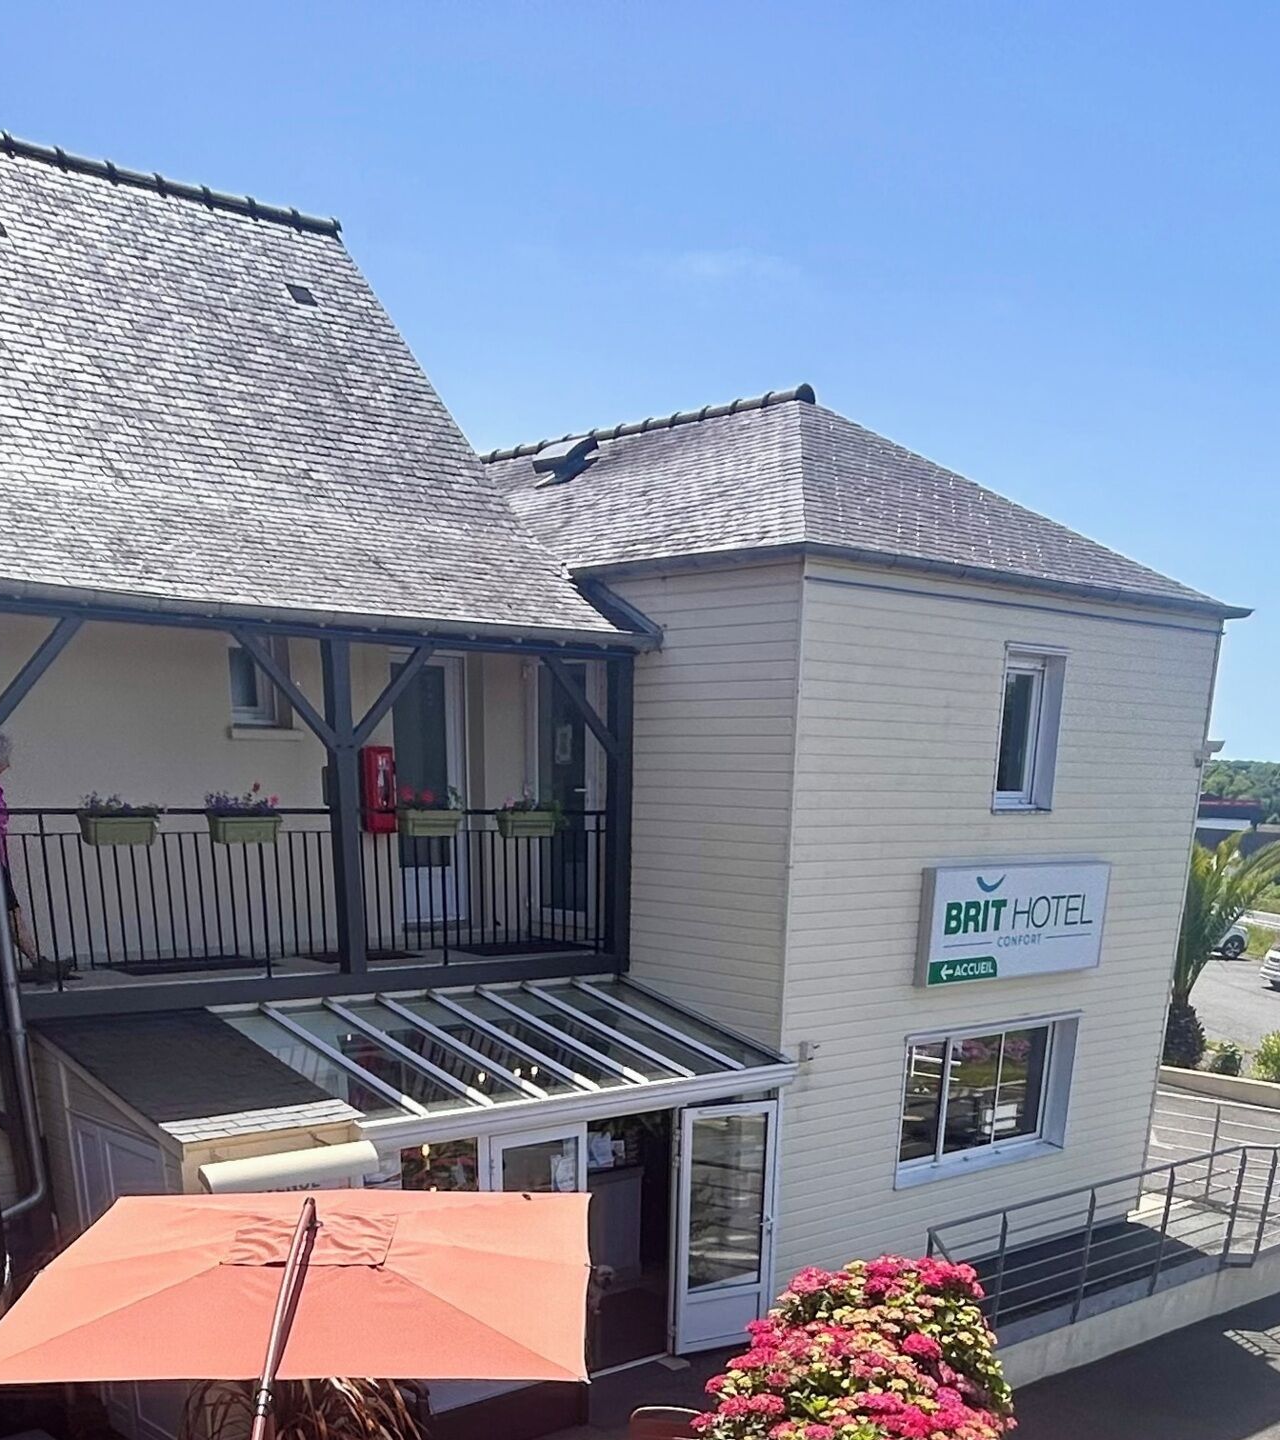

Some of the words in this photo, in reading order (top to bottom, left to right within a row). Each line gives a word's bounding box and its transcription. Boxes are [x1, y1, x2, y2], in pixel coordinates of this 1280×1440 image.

[944, 899, 1007, 935] BRIT
[1012, 893, 1093, 929] HOTEL
[997, 933, 1042, 948] CONFORT
[954, 961, 995, 977] ACCUEIL
